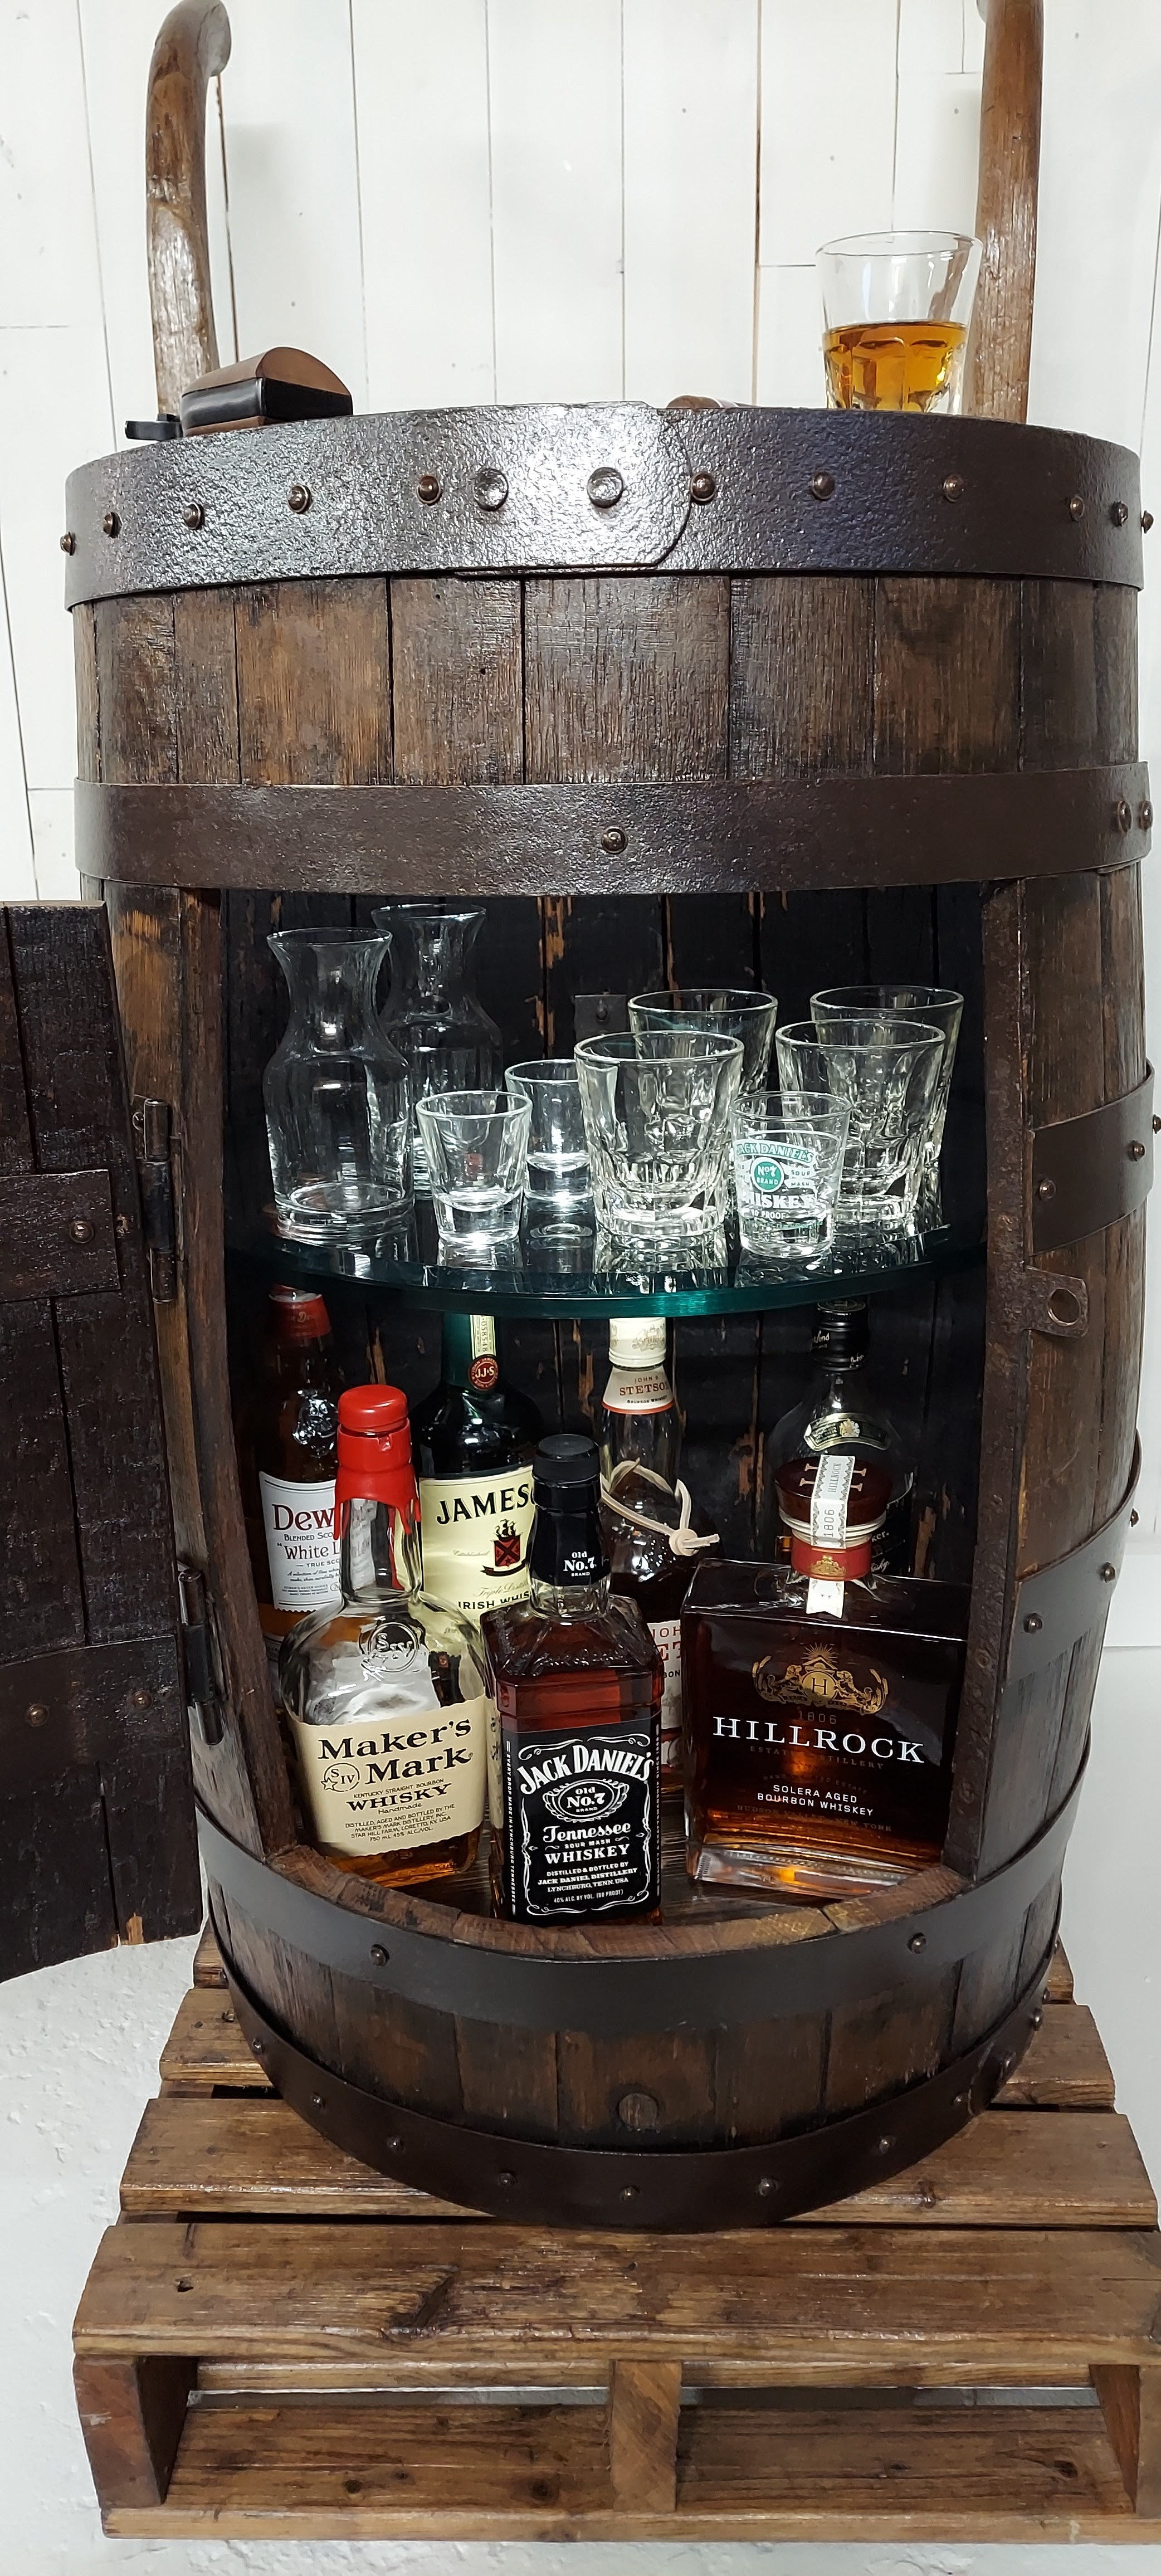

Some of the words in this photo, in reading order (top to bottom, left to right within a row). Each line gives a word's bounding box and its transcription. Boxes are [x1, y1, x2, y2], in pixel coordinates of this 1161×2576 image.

[736, 1143, 758, 1155] JACK
[759, 1143, 814, 1163] DANIEL'S
[761, 1210, 787, 1219] PROOF
[828, 1462, 842, 1493] HILLROCK
[823, 1509, 835, 1538] 1806
[284, 1534, 315, 1542] BLENDED
[563, 1556, 595, 1572] No.7
[457, 1600, 495, 1609] IRISH
[811, 1677, 828, 1696] H
[797, 1710, 837, 1724] 1806
[318, 1719, 471, 1760] Maker's
[713, 1716, 925, 1764] HILLROCK
[365, 1747, 471, 1785] Mark
[750, 1745, 787, 1756] ESTAT
[819, 1754, 884, 1770] STILLERY
[516, 1754, 573, 1795] JACK
[572, 1745, 655, 1782] DANIEL'S
[346, 1783, 452, 1811] WHISKY
[353, 1789, 384, 1798] KENTUCKY
[385, 1784, 413, 1794] STRAIGHT
[416, 1778, 444, 1788] BOURBON
[575, 1787, 596, 1795] Old
[773, 1784, 820, 1798] SOLERA
[825, 1791, 858, 1803] AGED
[378, 1803, 423, 1815] Handmade
[566, 1792, 606, 1808] No.7
[757, 1792, 814, 1807] BOURBON
[819, 1801, 874, 1816] WHISKEY
[402, 1816, 435, 1825] DISTILLERY,
[408, 1809, 435, 1818] BOTTLED
[401, 1821, 429, 1831] LORETTO,
[543, 1822, 631, 1843] Tennessee
[863, 1822, 892, 1832] YORK
[544, 1843, 630, 1864] WHISKEY
[559, 1875, 591, 1884] DANIEL
[591, 1867, 638, 1879] DISTILLERY
[588, 1863, 619, 1872] BOTTLED
[547, 1882, 593, 1892] LYNCHBURG,
